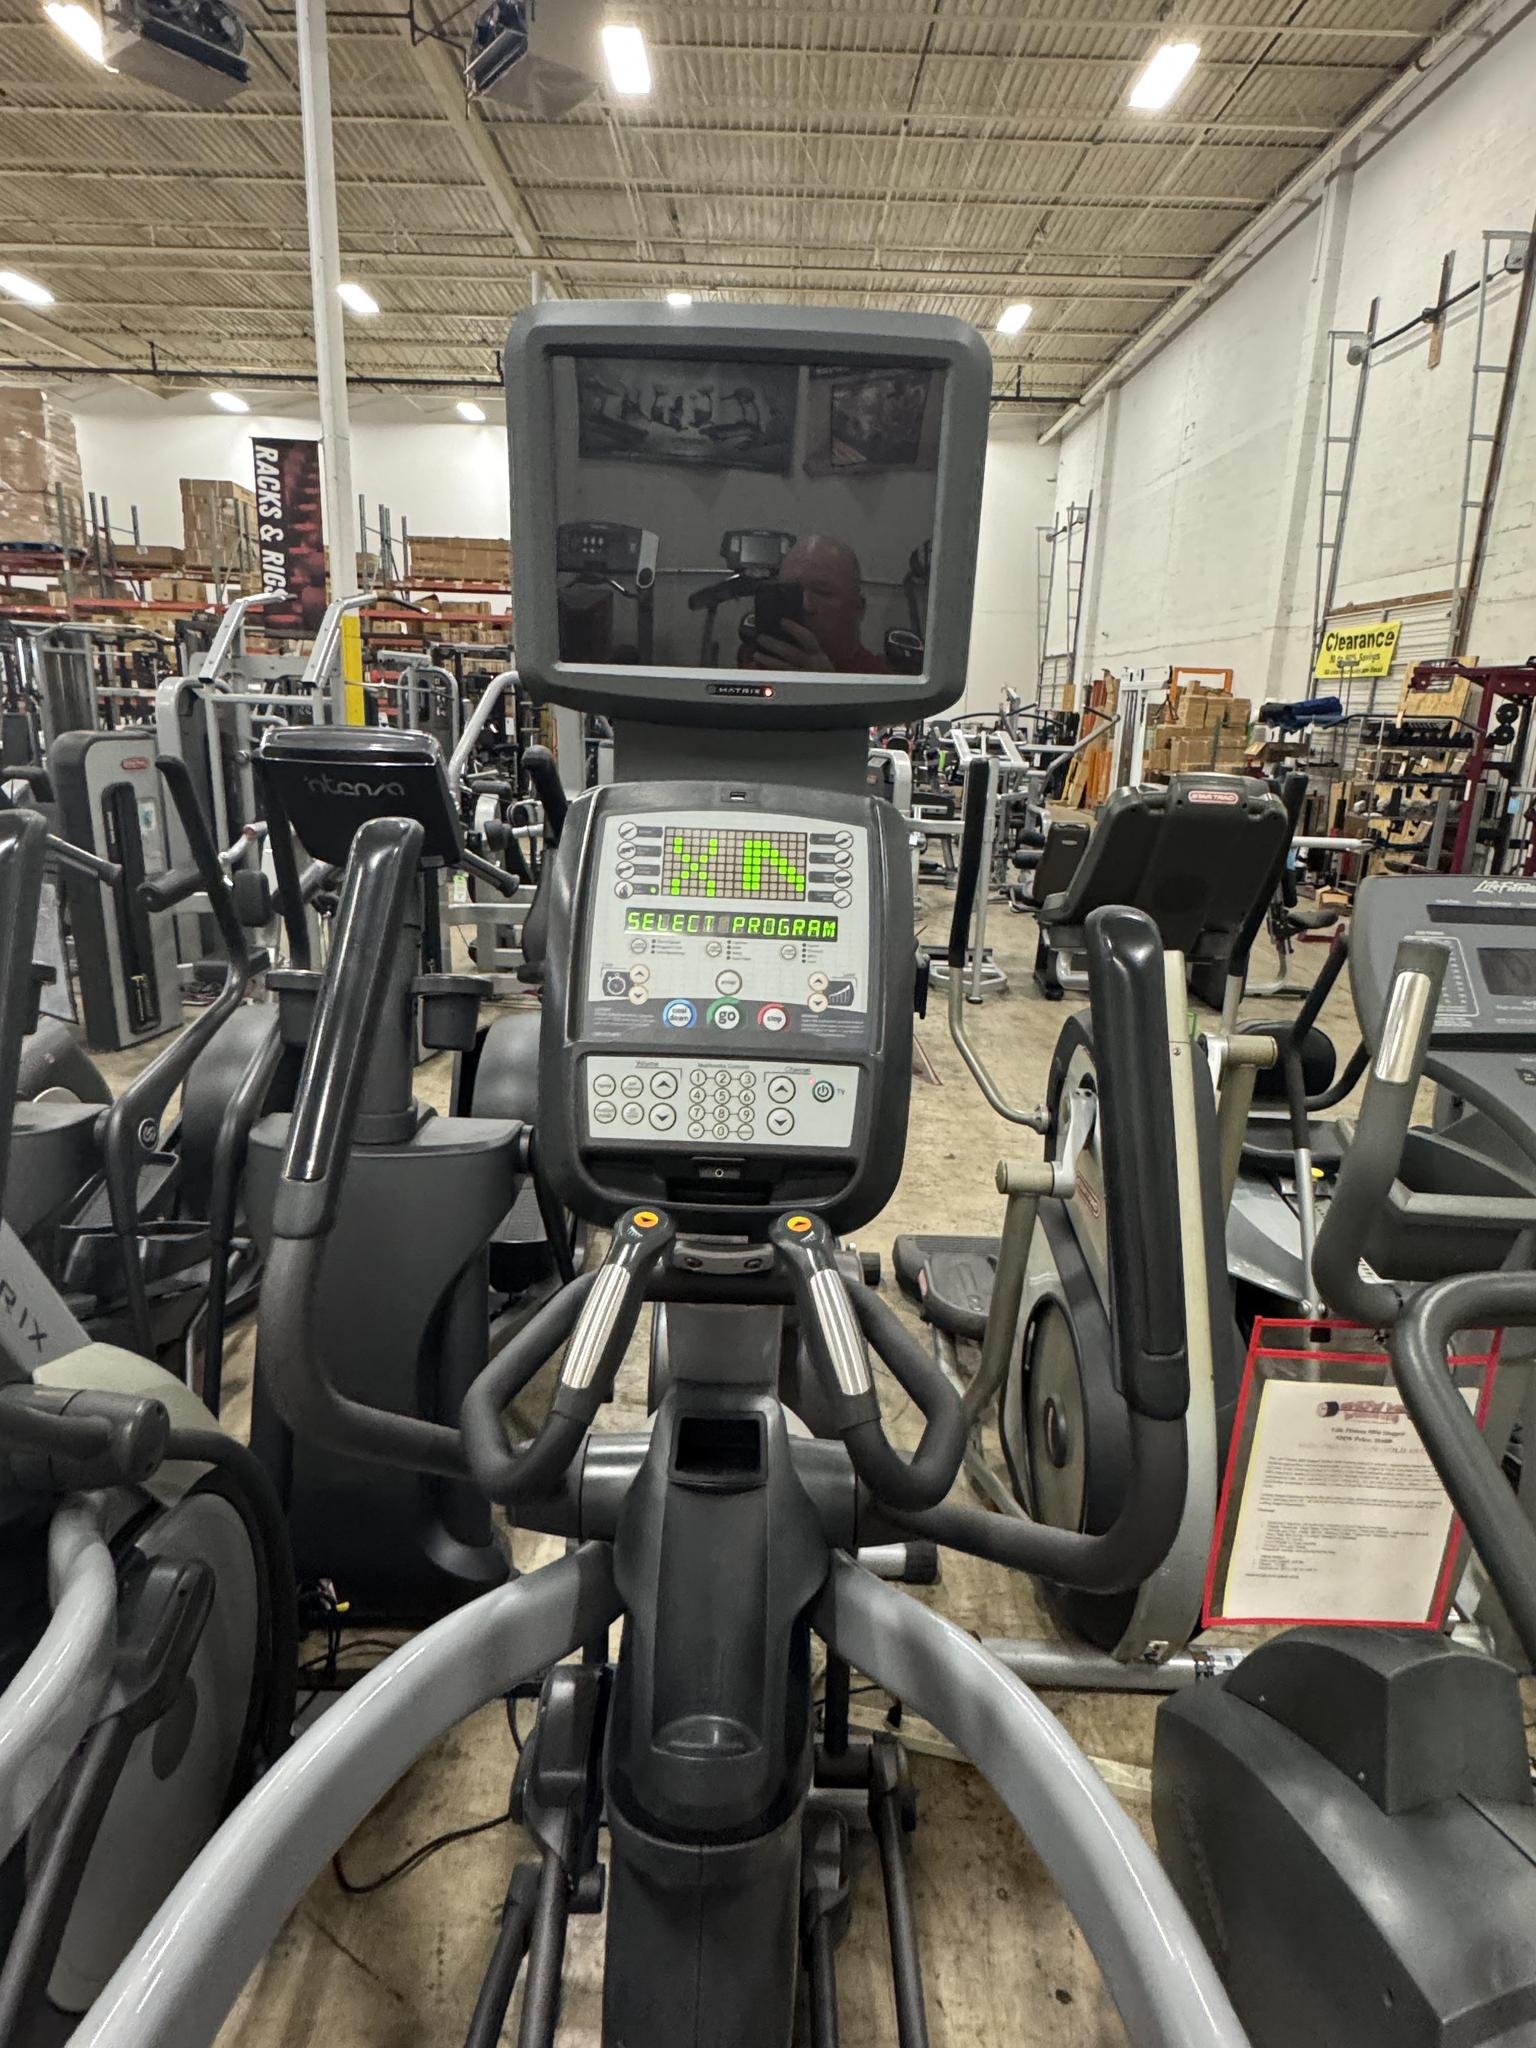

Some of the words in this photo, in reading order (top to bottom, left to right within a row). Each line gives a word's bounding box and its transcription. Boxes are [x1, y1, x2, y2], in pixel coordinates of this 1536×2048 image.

[255, 444, 283, 520] RACKS
[259, 524, 284, 542] &
[1326, 631, 1395, 652] Clearance
[718, 687, 761, 695] MATRIX
[627, 911, 715, 933] SELECT
[732, 915, 837, 938] PROGRAM
[719, 1010, 736, 1025] go
[767, 1015, 782, 1024] stop
[695, 1072, 700, 1083] 1
[719, 1073, 726, 1084] 2
[745, 1074, 751, 1085] 3
[693, 1090, 700, 1100] 4
[719, 1091, 726, 1101] 5
[744, 1092, 750, 1102] 6
[693, 1108, 700, 1118] 7
[718, 1109, 725, 1119] 8
[743, 1109, 750, 1120] 9
[717, 1126, 725, 1136] 0
